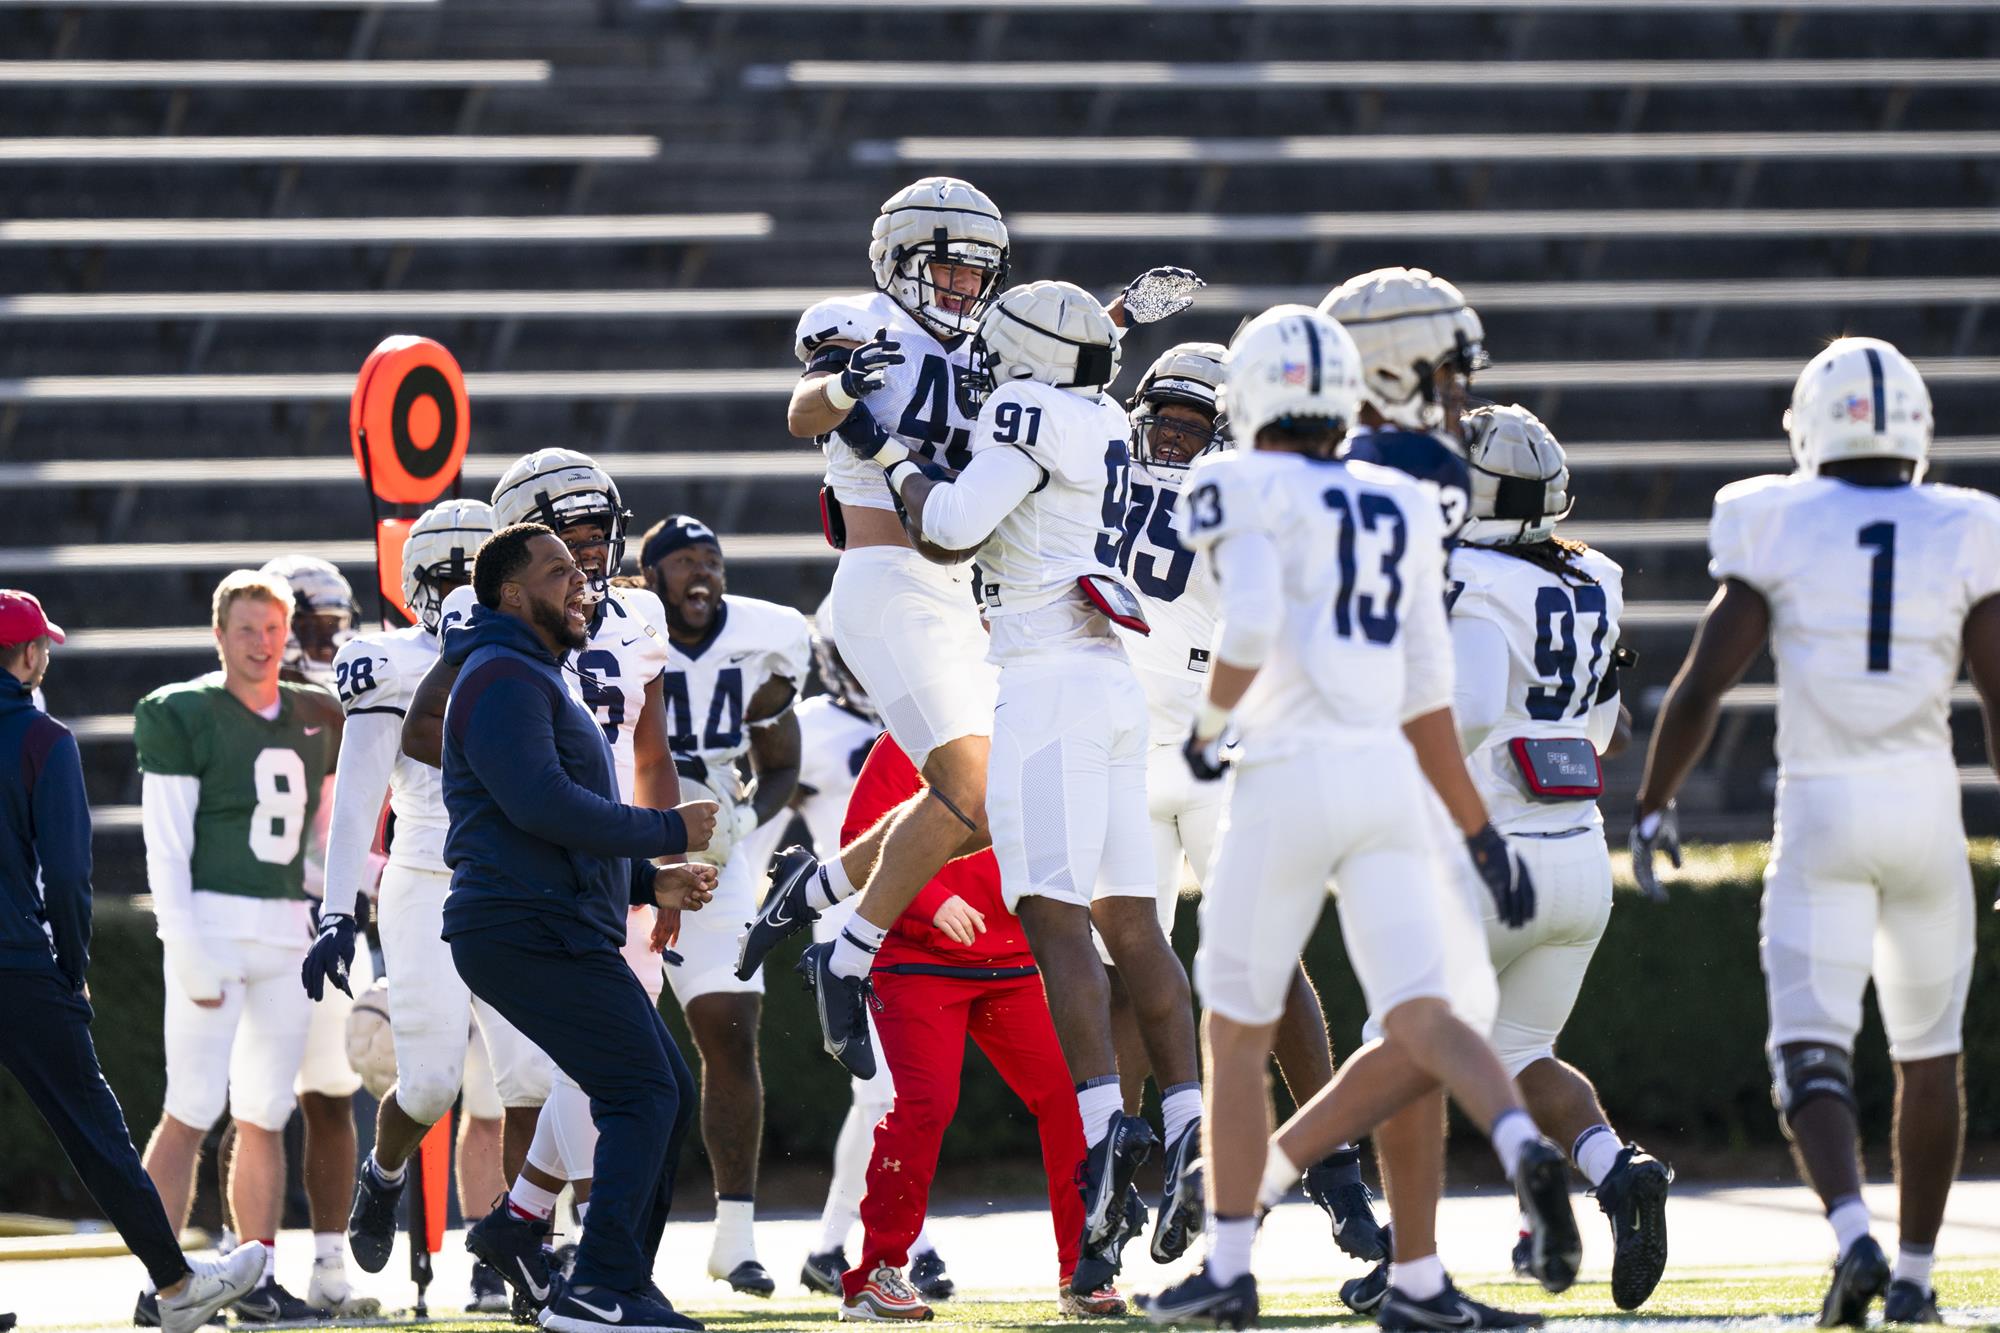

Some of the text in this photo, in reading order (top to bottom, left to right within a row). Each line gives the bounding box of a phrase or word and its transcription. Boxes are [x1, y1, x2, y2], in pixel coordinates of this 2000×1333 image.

[993, 402, 1041, 446] 91
[987, 586, 995, 594] XL
[1118, 482, 1198, 602] 75
[1323, 488, 1407, 644] 13
[1858, 520, 1896, 671] 1
[336, 656, 377, 702] 28
[1525, 585, 1608, 721] 97
[248, 748, 308, 865] 8
